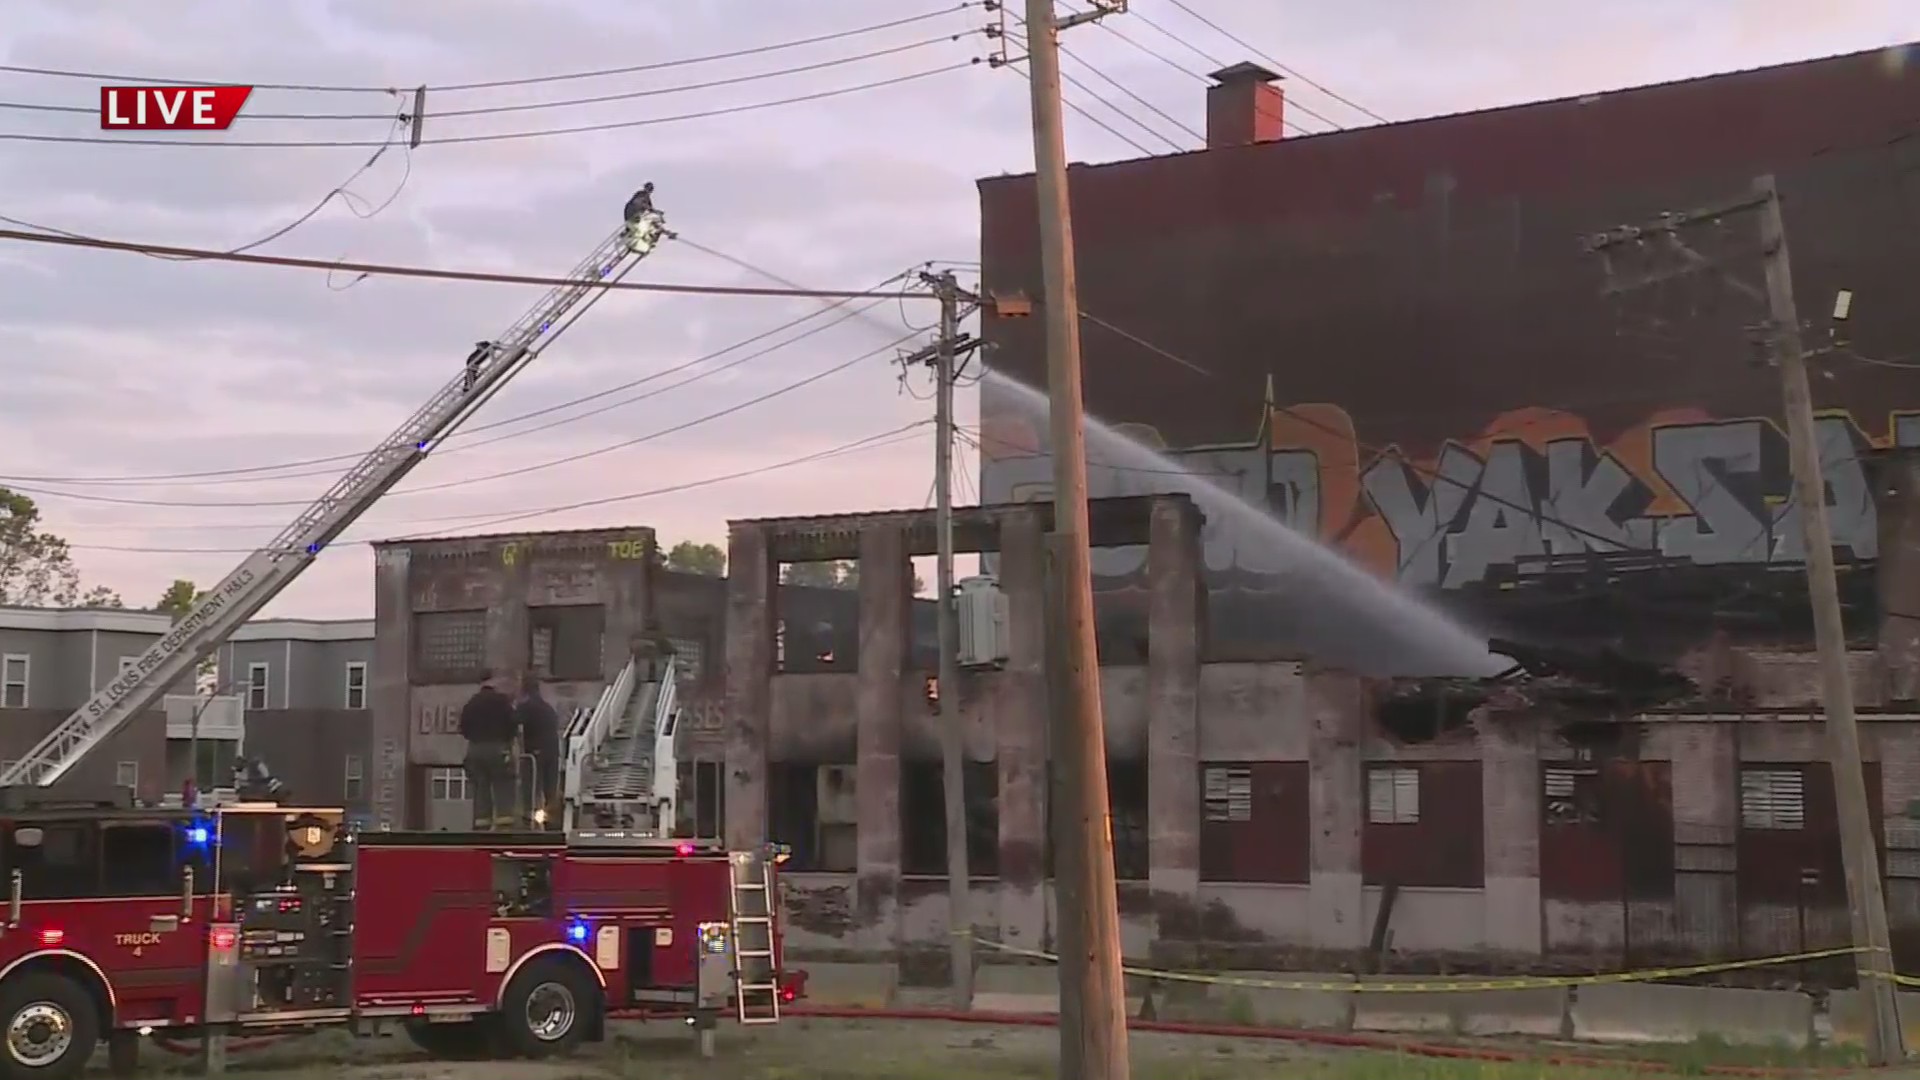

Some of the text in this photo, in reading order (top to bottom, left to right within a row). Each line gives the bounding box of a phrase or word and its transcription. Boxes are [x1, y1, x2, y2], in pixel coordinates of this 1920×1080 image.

[88, 697, 110, 716] ST.
[106, 670, 139, 701] LOUIS
[137, 649, 163, 674] FIRE
[161, 593, 225, 652] DEPARTMENT
[114, 932, 161, 946] TRUCK
[132, 946, 142, 957] 4
